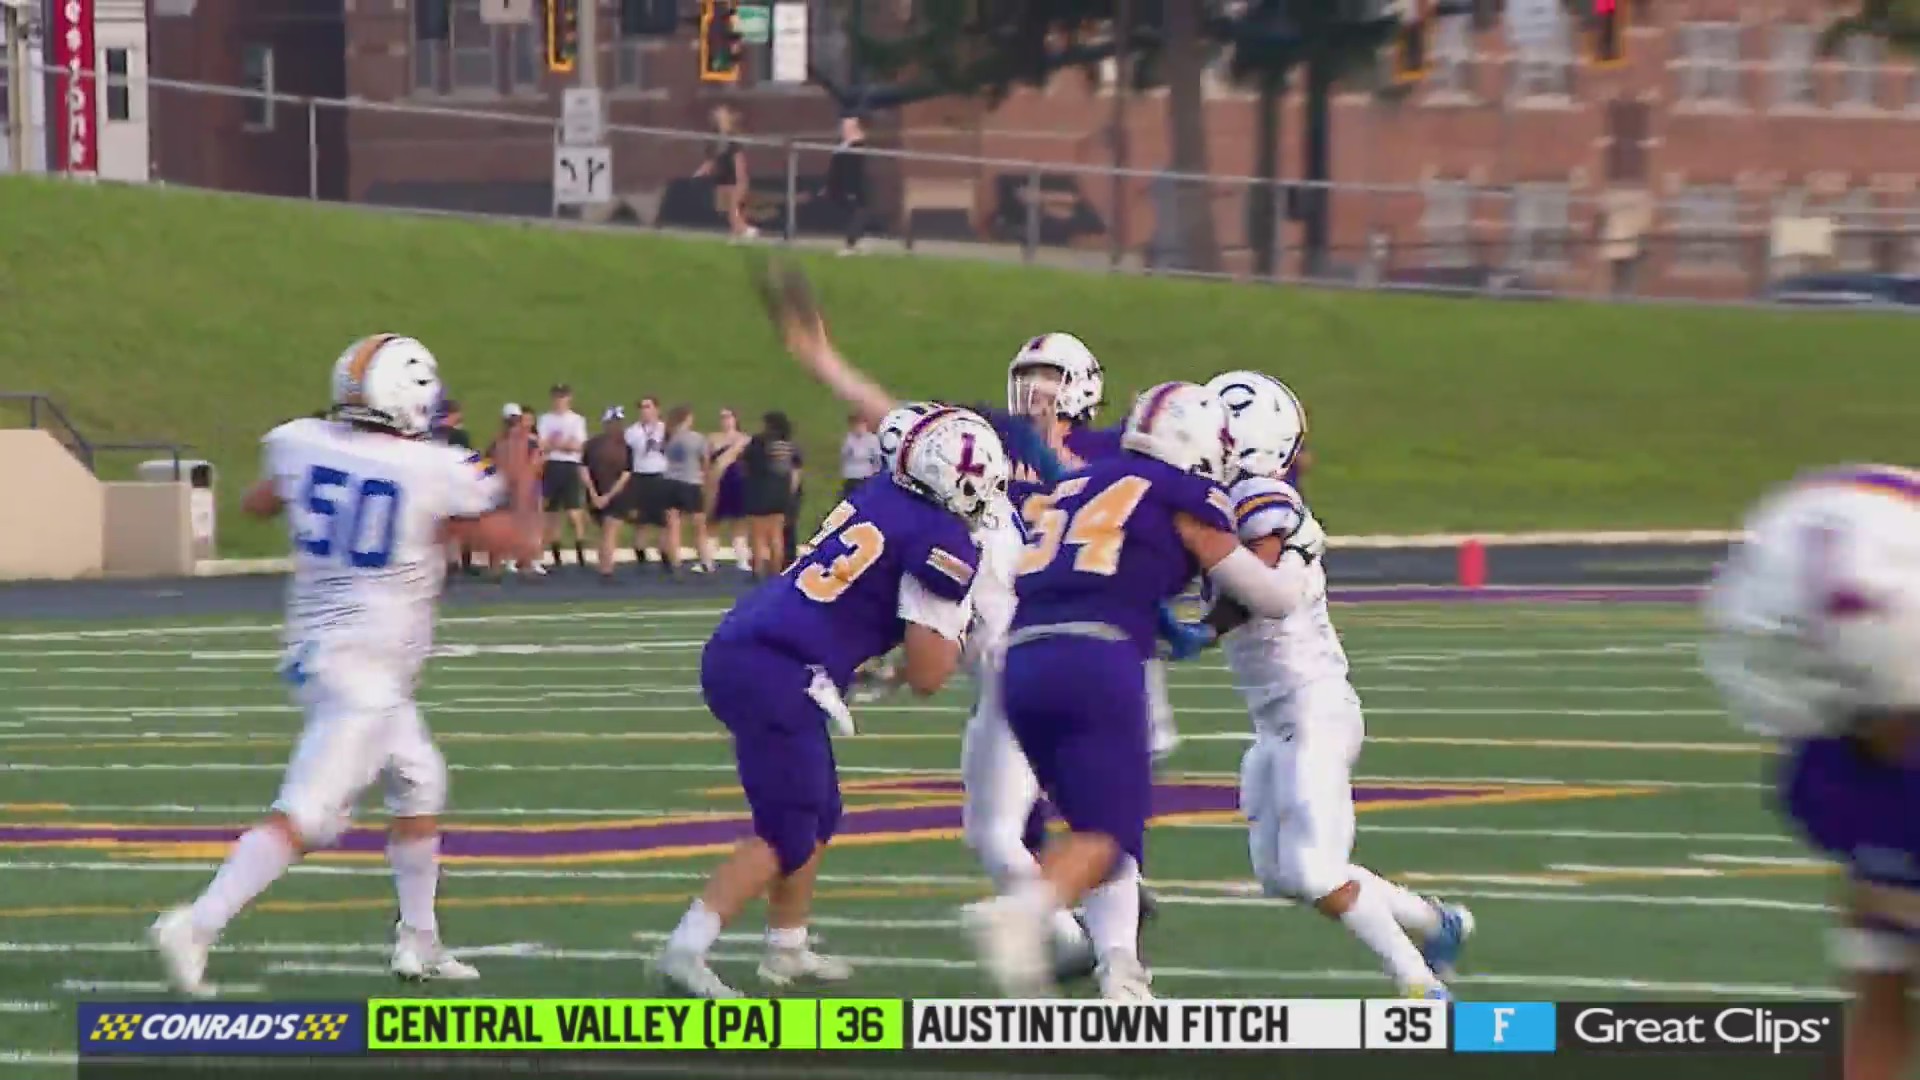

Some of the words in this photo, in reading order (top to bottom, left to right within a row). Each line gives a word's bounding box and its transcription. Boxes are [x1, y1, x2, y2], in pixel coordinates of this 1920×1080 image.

[956, 432, 986, 477] L
[295, 465, 402, 569] 50
[1008, 475, 1153, 577] 54
